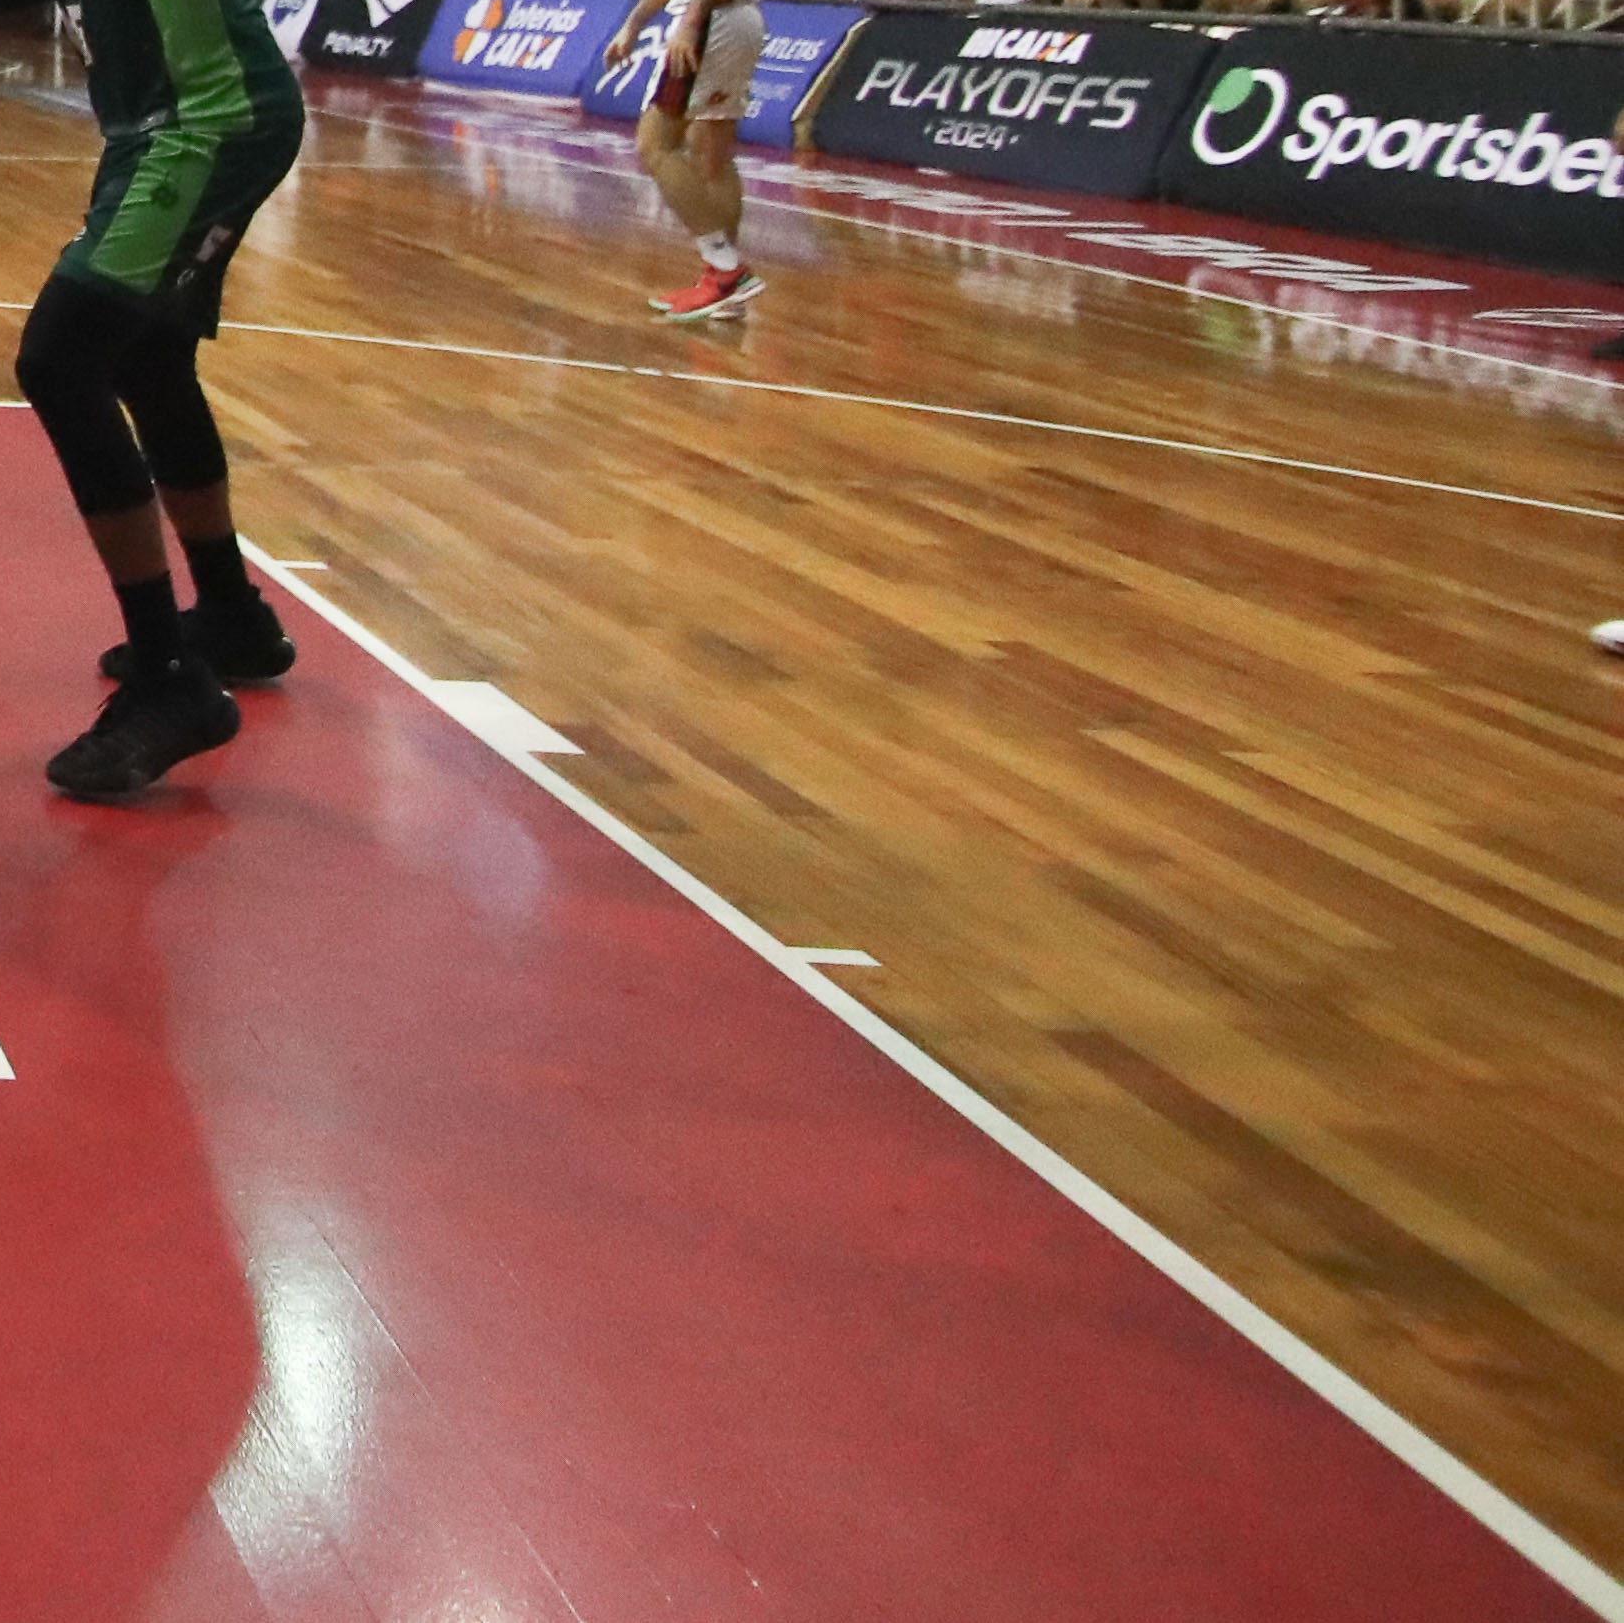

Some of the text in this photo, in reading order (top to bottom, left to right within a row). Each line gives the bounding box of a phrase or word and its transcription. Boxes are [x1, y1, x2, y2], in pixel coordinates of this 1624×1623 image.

[483, 32, 566, 70] CAIXA
[994, 29, 1092, 64] CAIXA
[856, 58, 1150, 128] PLAYOFFS
[934, 120, 1009, 151] 2024
